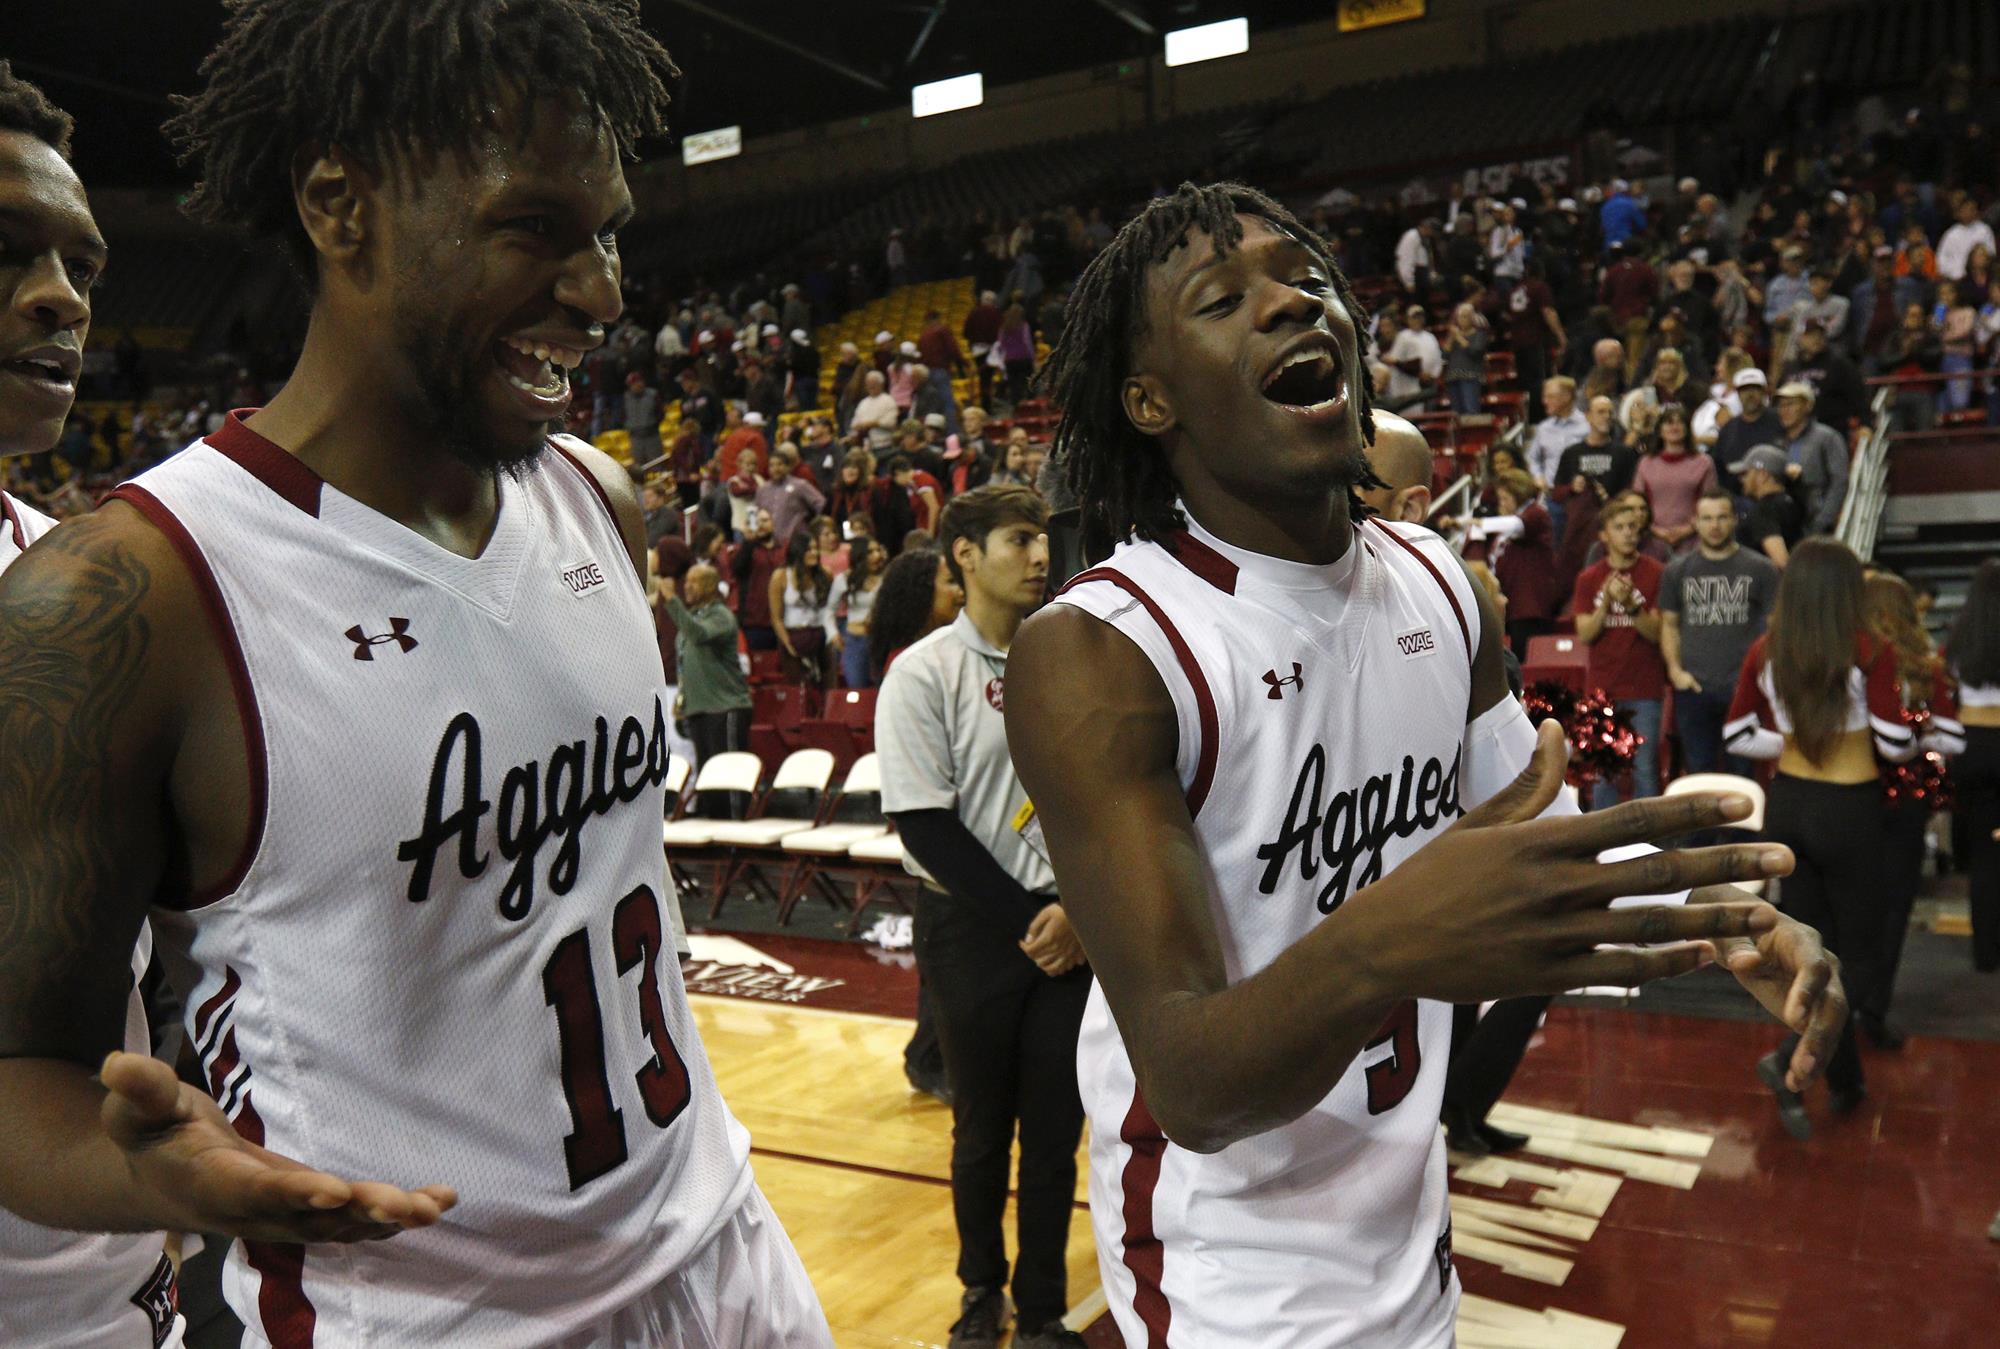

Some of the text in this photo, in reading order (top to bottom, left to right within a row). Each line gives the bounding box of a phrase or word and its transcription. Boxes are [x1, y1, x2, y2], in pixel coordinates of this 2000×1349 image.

[563, 563, 604, 592] WAC
[1683, 575, 1753, 607] NM
[1687, 603, 1750, 626] STATE
[1397, 630, 1434, 655] WAC
[397, 694, 671, 921] Aggies
[1256, 738, 1467, 915] Aggies
[542, 884, 692, 1192] 13
